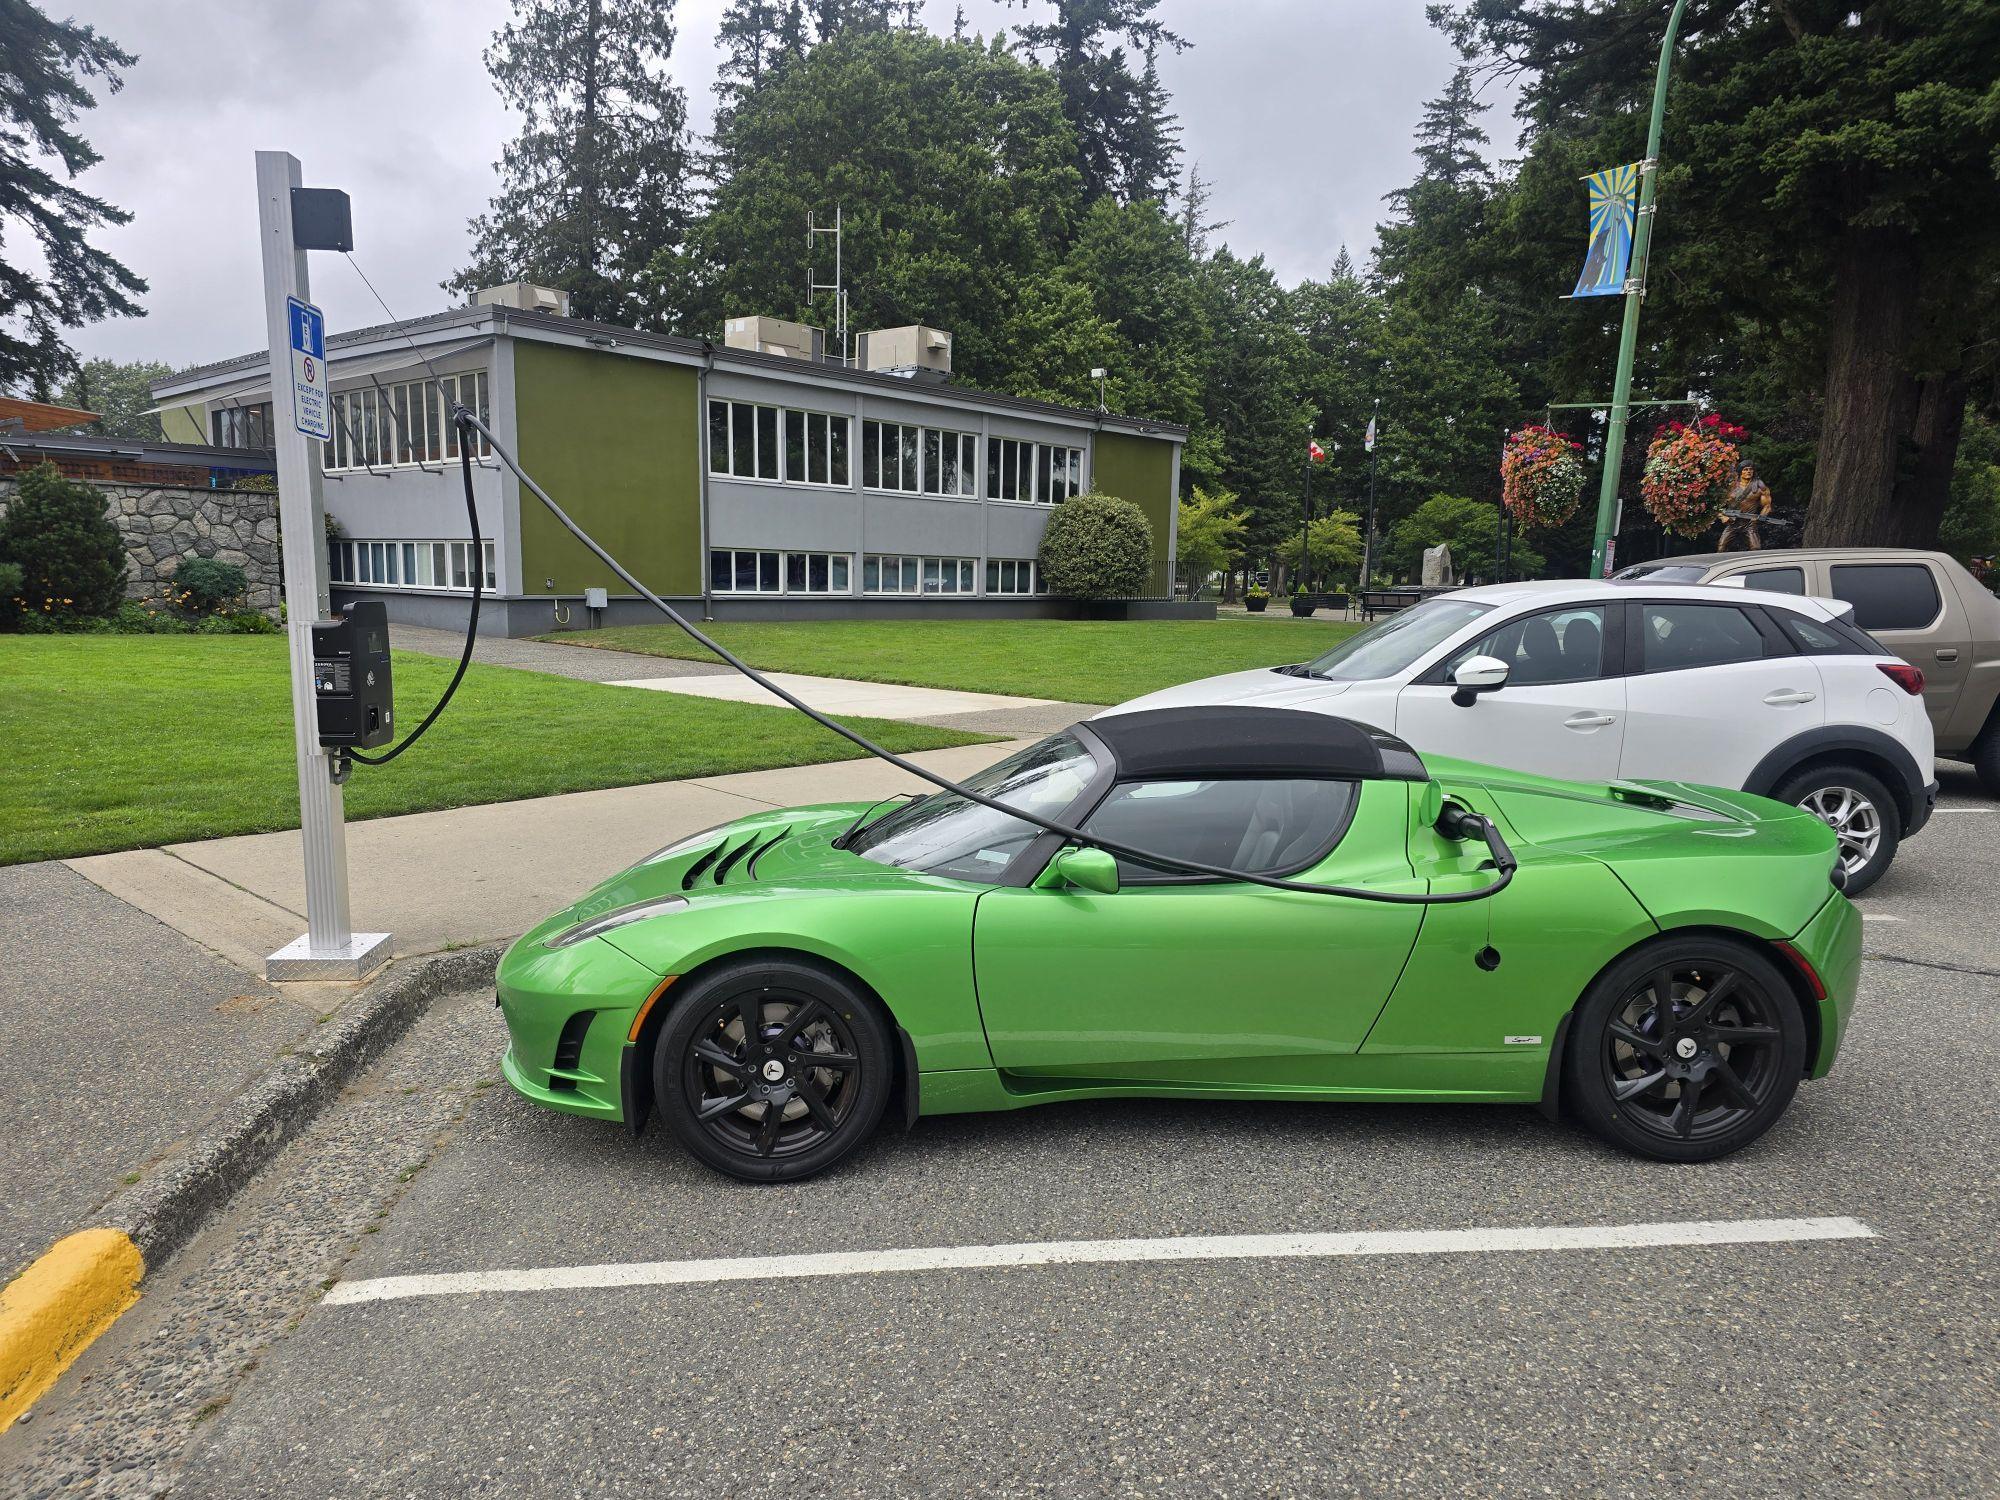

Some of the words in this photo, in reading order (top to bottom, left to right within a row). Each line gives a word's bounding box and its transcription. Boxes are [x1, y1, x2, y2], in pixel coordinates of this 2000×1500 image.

[297, 382, 314, 395] EXCEPT
[315, 389, 324, 398] FOR
[301, 395, 321, 408] ELECTRIC
[303, 407, 321, 419] VEHICLE
[302, 417, 324, 430] CHARGING
